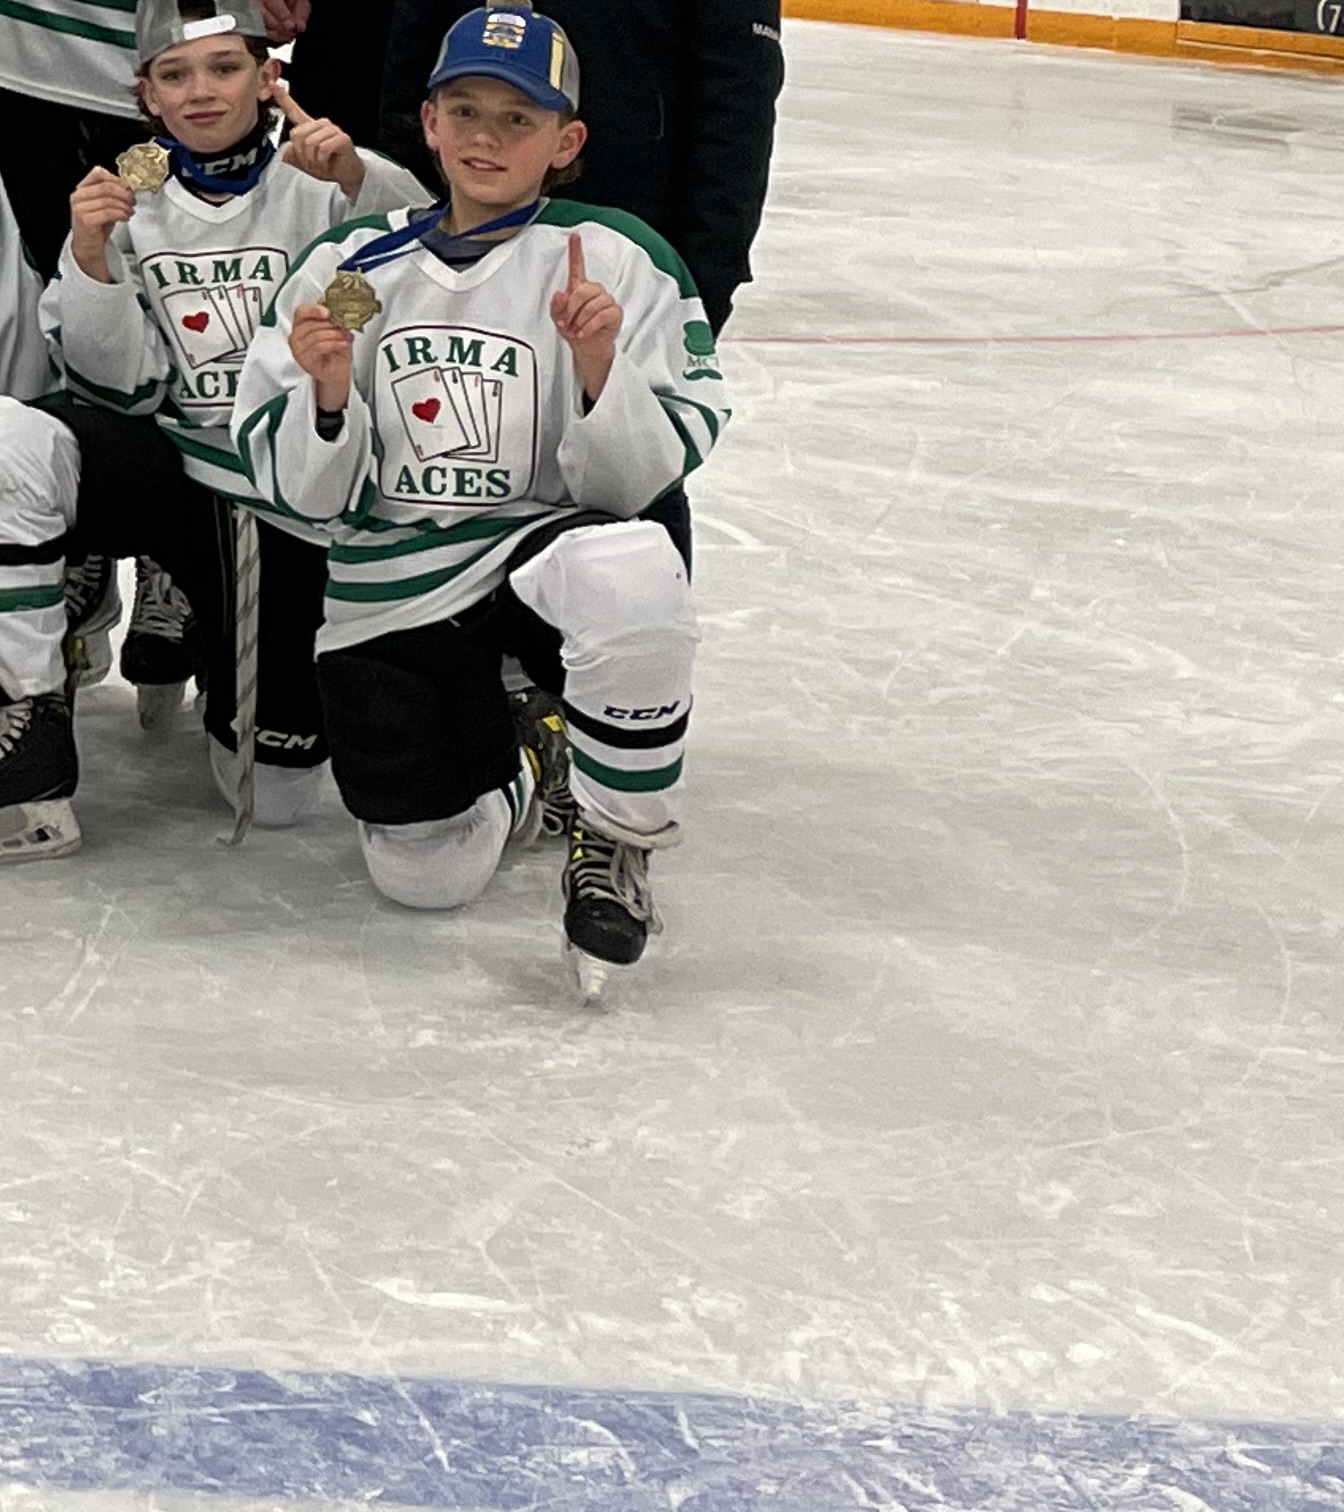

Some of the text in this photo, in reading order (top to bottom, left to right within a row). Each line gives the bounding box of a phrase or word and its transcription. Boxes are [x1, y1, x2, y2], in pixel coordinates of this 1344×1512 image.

[149, 255, 274, 288] IRMA
[381, 335, 520, 377] IRMA
[393, 464, 512, 498] ACES
[234, 719, 319, 751] CM
